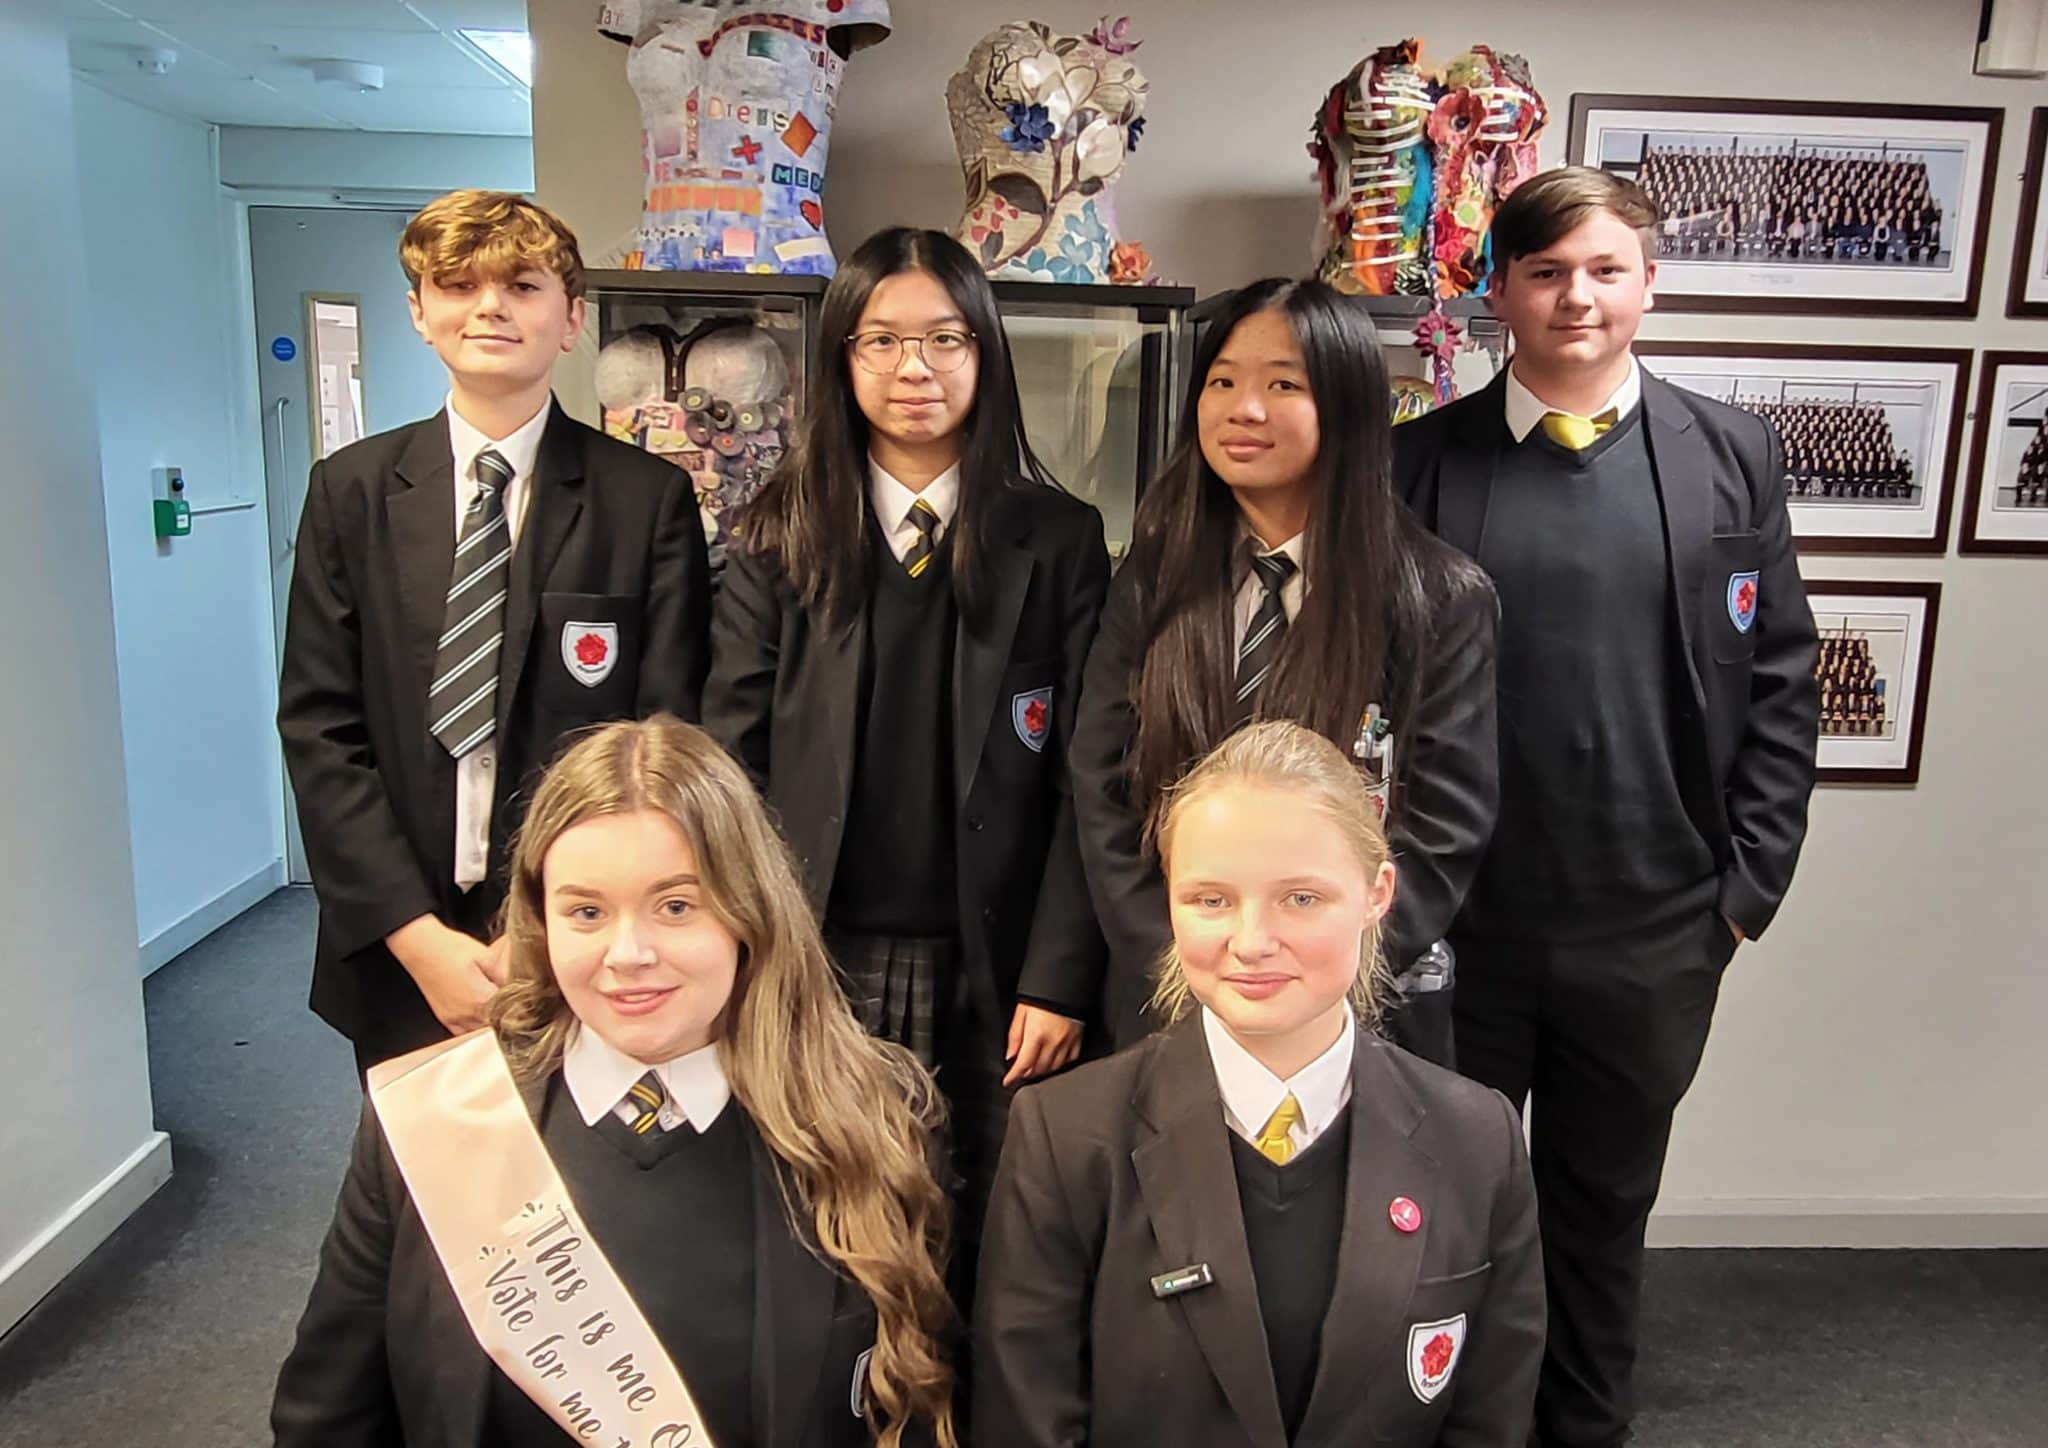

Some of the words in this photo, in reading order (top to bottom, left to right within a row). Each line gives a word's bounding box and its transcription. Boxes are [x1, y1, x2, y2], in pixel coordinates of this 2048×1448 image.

[485, 1255, 538, 1332] Vote
[526, 1334, 568, 1380] for
[560, 1392, 602, 1440] me
[526, 1204, 588, 1302] This
[578, 1311, 615, 1346] is
[607, 1353, 656, 1412] me
